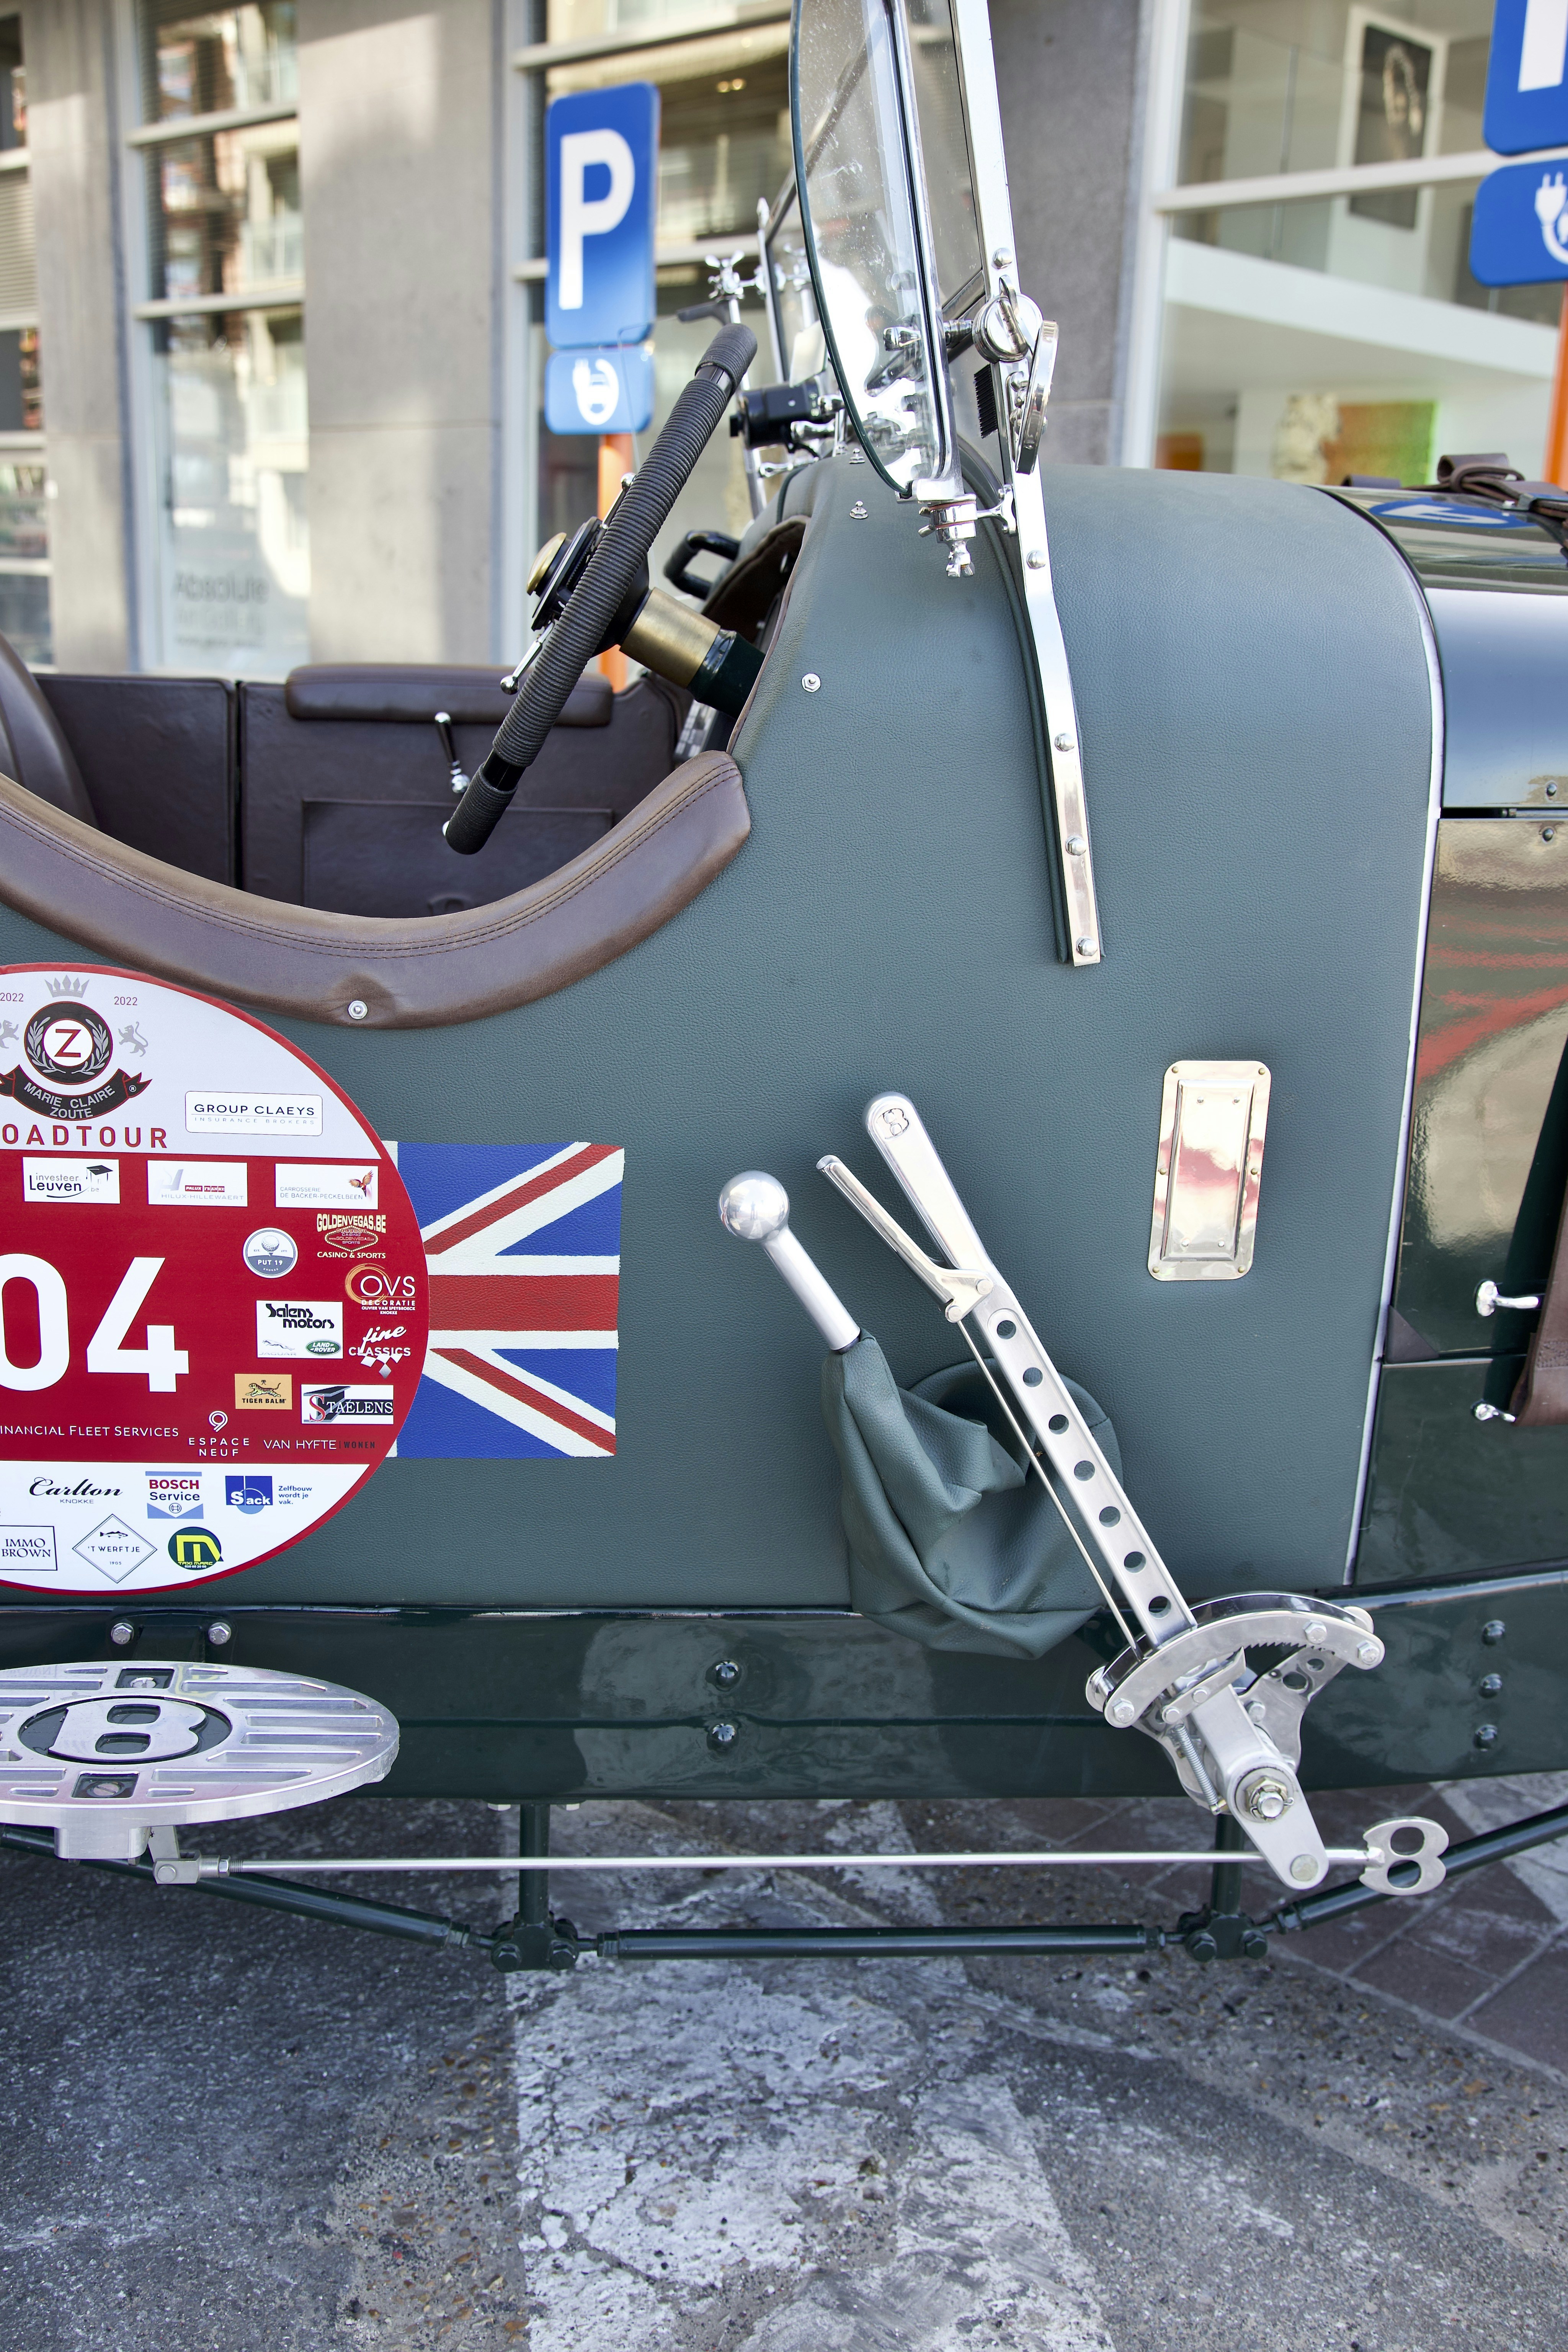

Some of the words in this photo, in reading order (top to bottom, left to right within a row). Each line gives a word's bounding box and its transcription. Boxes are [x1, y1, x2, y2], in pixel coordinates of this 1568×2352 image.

[559, 128, 636, 310] P
[0, 993, 24, 1002] 2022
[114, 996, 138, 1006] 2022
[54, 1029, 82, 1058] Z
[24, 1082, 62, 1107] MARIE
[70, 1085, 116, 1109] CLAIRE
[50, 1107, 93, 1119] ZOUTE
[194, 1104, 248, 1114] GROUP
[255, 1106, 314, 1116] CLAEYS
[2, 1124, 167, 1148] OADTOUR
[29, 1175, 82, 1191] Leuven
[36, 1173, 79, 1181] investeer
[317, 1213, 386, 1234] GOLDENVEGAS.BE
[361, 1276, 415, 1297] OVS
[283, 1318, 335, 1329] motors
[360, 1326, 407, 1353] fine
[349, 1347, 411, 1357] CLASSICS
[309, 1394, 393, 1422] STAELENS
[70, 1426, 110, 1436] FLEET
[114, 1426, 179, 1437] SERVICES
[189, 1437, 250, 1446] ESPACE
[263, 1440, 290, 1449] VAN
[296, 1440, 336, 1449] HYFTE
[199, 1449, 238, 1457] NEUF
[29, 1477, 123, 1496] Carlton
[149, 1479, 199, 1490] BOSCH
[150, 1491, 200, 1501] Service
[230, 1491, 271, 1505] Sack
[5, 1538, 45, 1548] IMMO
[1, 1548, 51, 1558] BROWN
[48, 1698, 207, 1762] B
